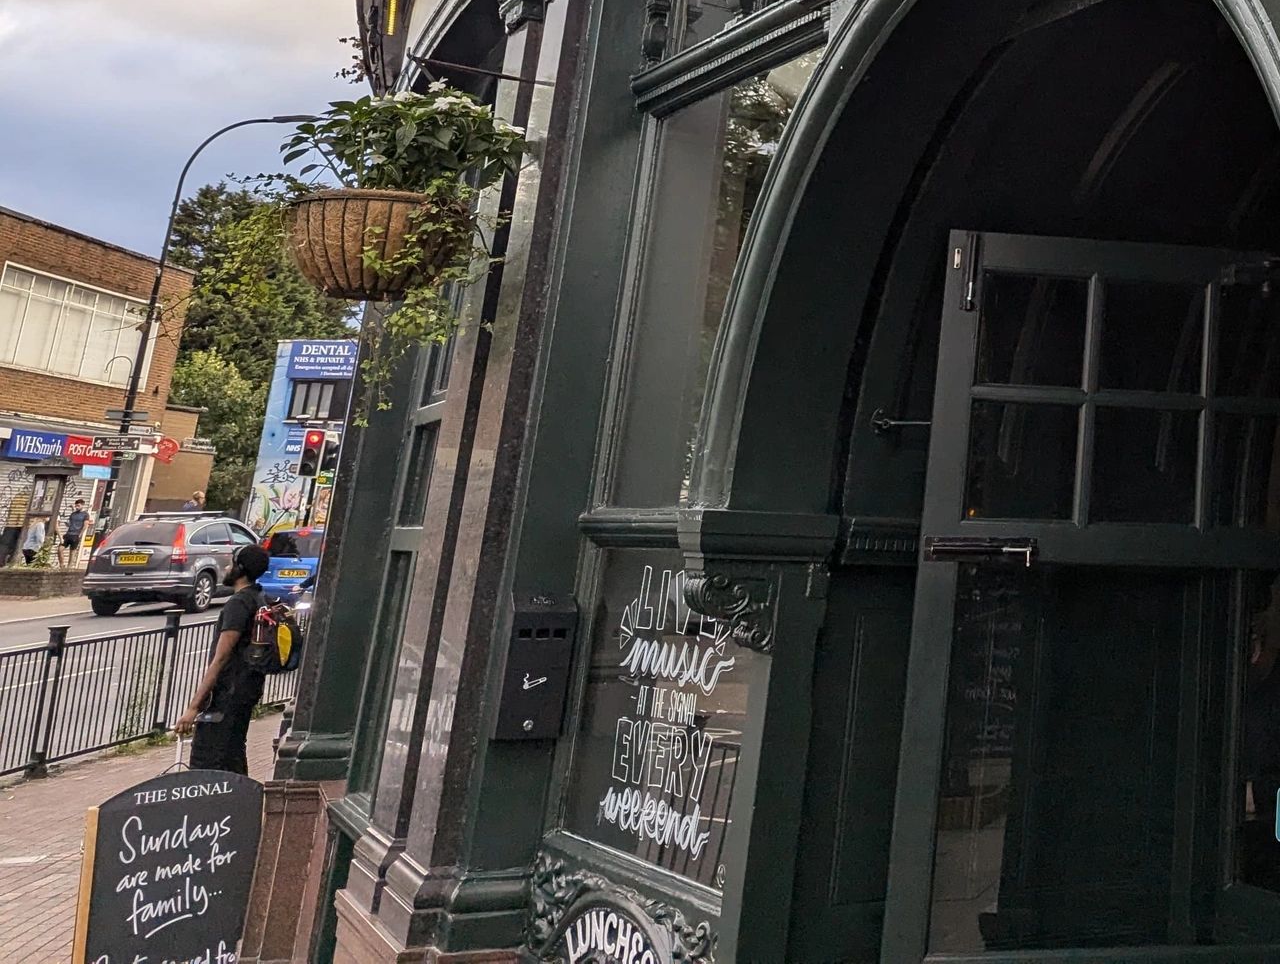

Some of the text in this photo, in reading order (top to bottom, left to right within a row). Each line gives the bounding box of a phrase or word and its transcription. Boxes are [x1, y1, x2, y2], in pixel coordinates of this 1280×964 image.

[301, 344, 351, 356] DENTAL
[15, 434, 63, 456] WHSmith
[67, 443, 87, 455] POST
[285, 444, 301, 452] NHS
[635, 565, 718, 638] LIV
[619, 636, 736, 697] music
[636, 685, 698, 727] AT THE SIGNAL
[611, 717, 714, 802] EVERY
[134, 781, 233, 805] THE SIGNAL
[119, 815, 232, 864] Sundays
[599, 786, 711, 861] weekend
[116, 843, 237, 893] are made for
